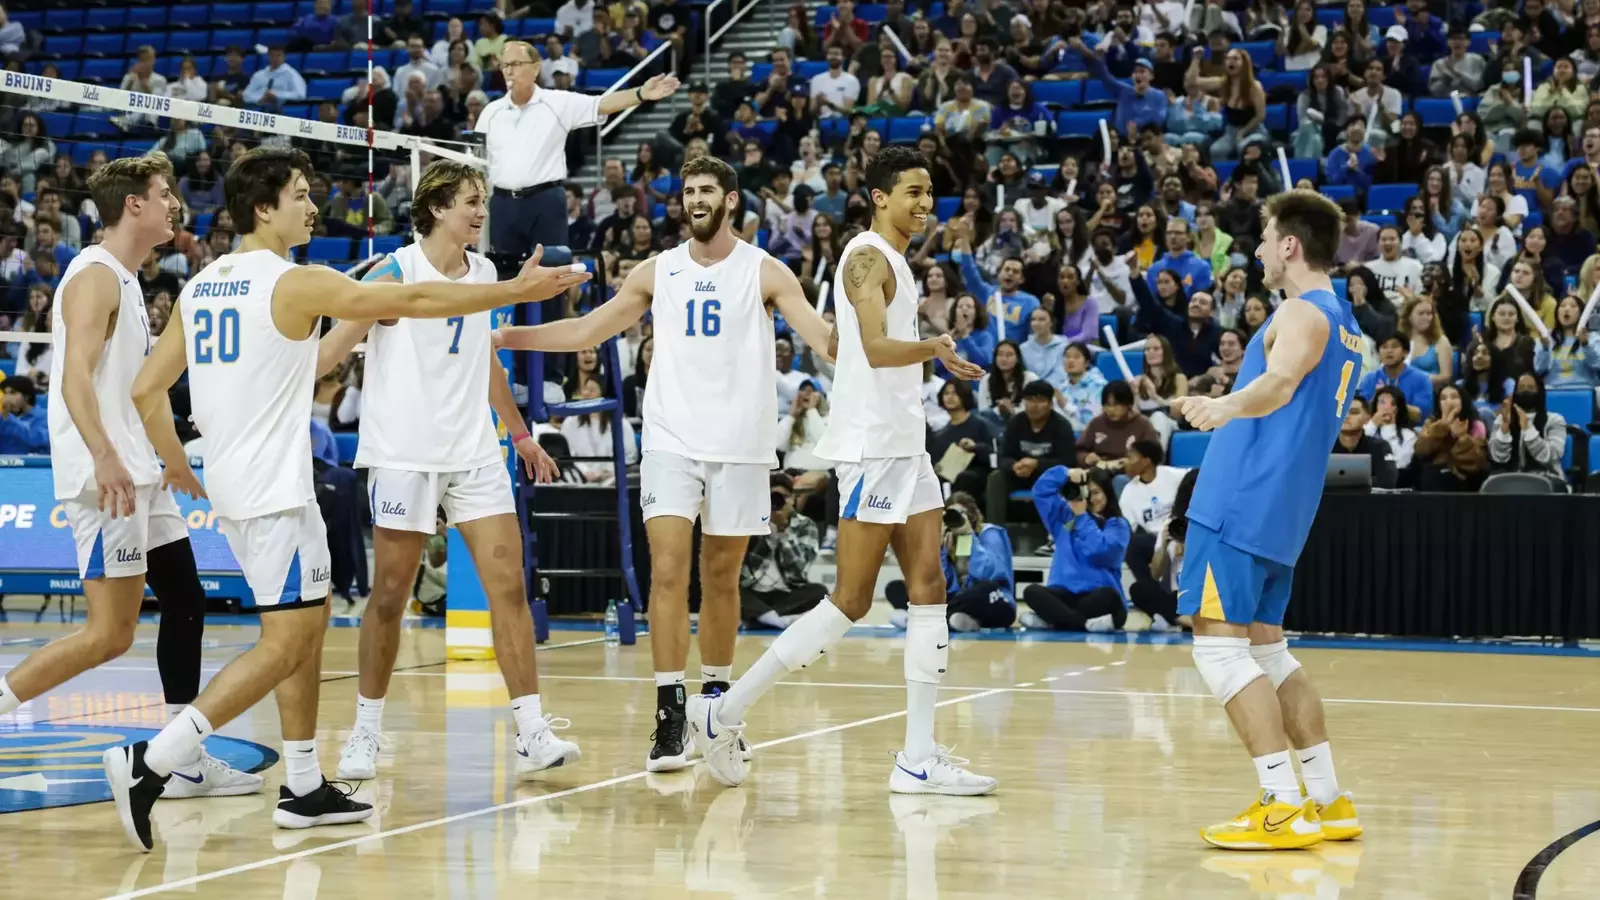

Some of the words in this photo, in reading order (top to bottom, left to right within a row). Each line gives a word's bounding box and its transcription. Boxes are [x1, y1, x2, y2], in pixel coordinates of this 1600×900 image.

[5, 73, 52, 92] BRUINS
[83, 85, 100, 101] Ucla
[129, 93, 171, 112] BRUINS
[239, 111, 276, 128] BRUINS
[192, 280, 251, 298] BRUINS
[694, 281, 716, 292] Ucla
[685, 299, 721, 337] 16
[193, 307, 240, 364] 20
[447, 316, 464, 354] 7
[1335, 360, 1355, 418] 4
[381, 501, 407, 516] Ucla
[867, 495, 893, 510] Ucla
[116, 547, 142, 563] Ucla
[311, 565, 330, 583] Ucla
